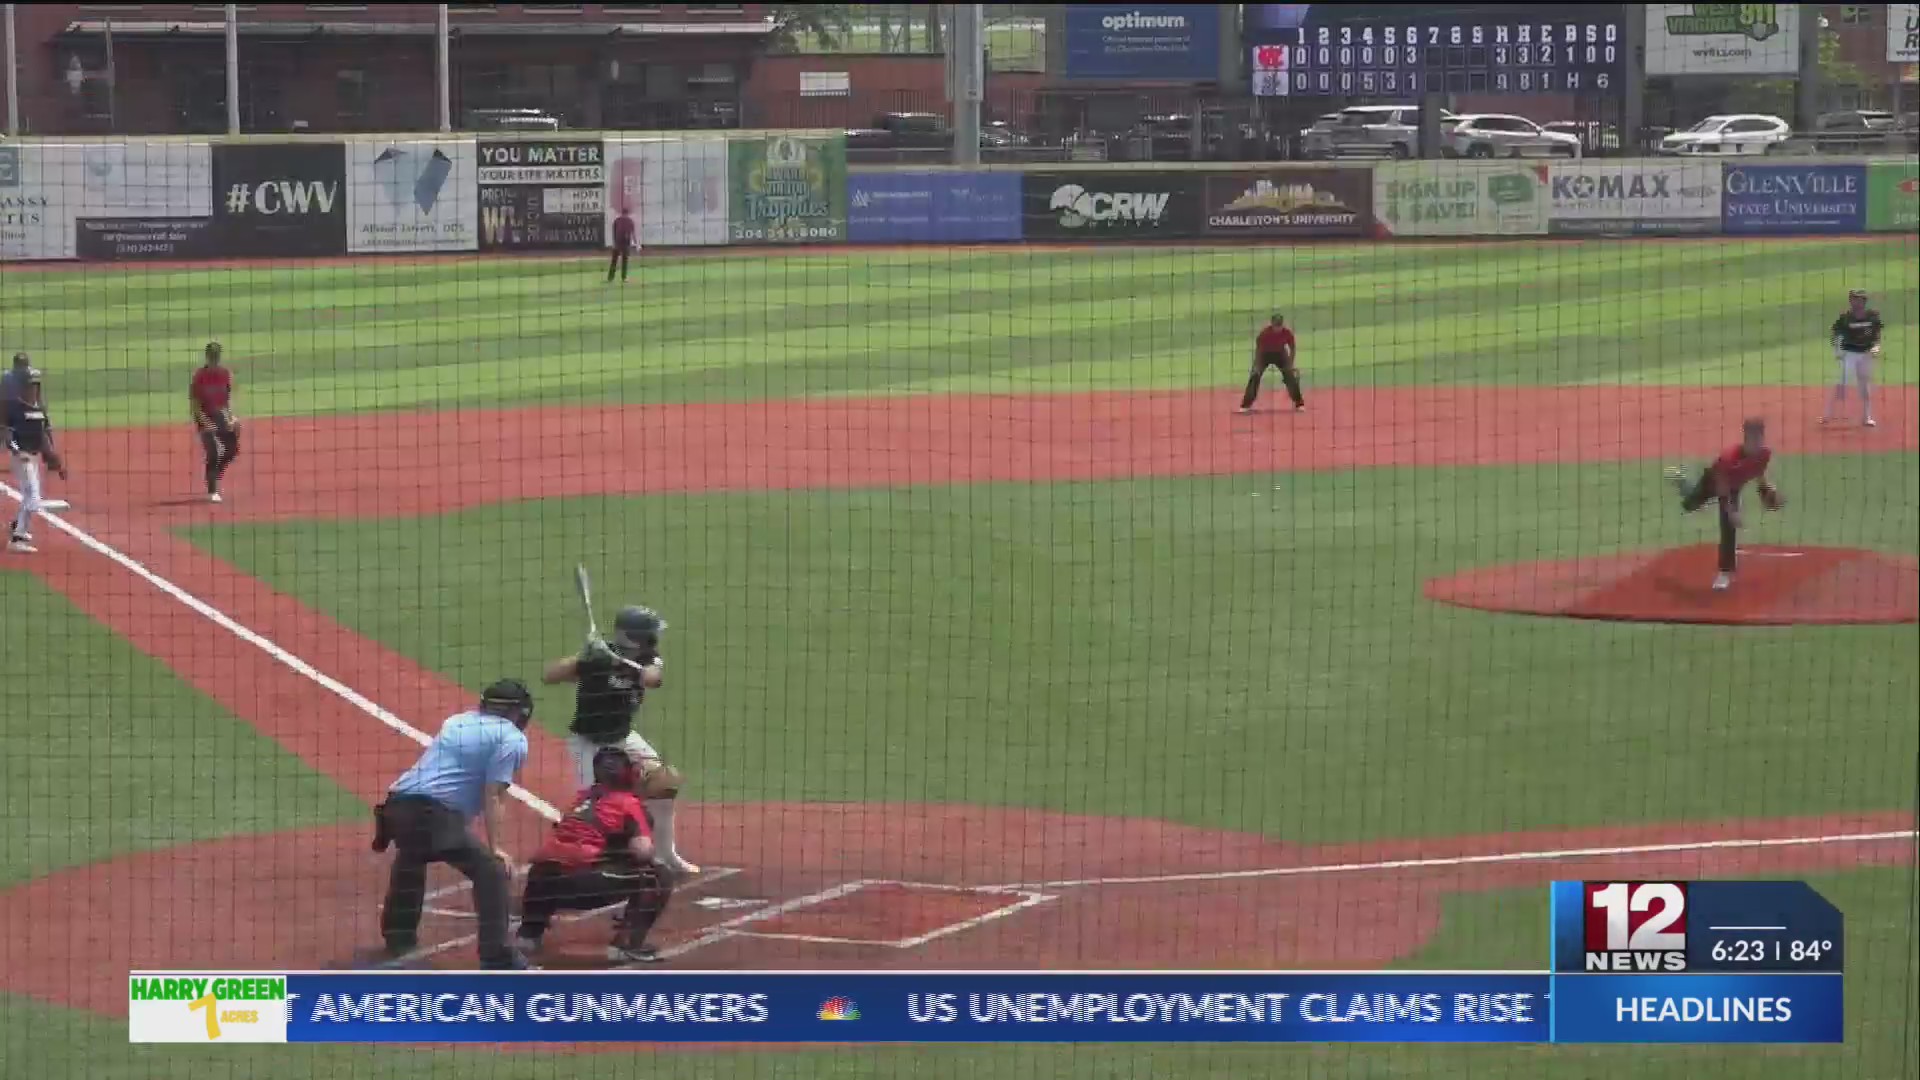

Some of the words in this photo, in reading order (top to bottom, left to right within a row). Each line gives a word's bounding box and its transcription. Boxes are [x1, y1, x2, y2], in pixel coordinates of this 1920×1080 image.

[1102, 11, 1185, 30] optimum
[1298, 27, 1305, 44] 1
[1319, 27, 1329, 44] 2
[1341, 27, 1351, 44] 3
[1362, 27, 1373, 44] 4
[1384, 27, 1395, 44] 5
[1406, 27, 1417, 44] 6
[1428, 27, 1439, 44] 7
[1451, 26, 1461, 43] 8
[1472, 26, 1483, 43] 9
[1518, 25, 1530, 43] H
[1541, 25, 1552, 43] E
[1565, 24, 1577, 42] B
[1585, 24, 1597, 42] S
[1297, 47, 1306, 64] 0
[1319, 47, 1329, 64] 0
[1341, 47, 1350, 64] 0
[1363, 47, 1373, 64] 0
[1384, 47, 1394, 64] 0
[1407, 47, 1416, 64] 3
[1518, 47, 1529, 64] 3
[1541, 47, 1552, 64] 2
[1566, 46, 1574, 63] 1
[1586, 46, 1596, 63] 0
[1605, 46, 1615, 63] 0
[1296, 72, 1306, 89] 0
[1319, 72, 1329, 89] 0
[1341, 72, 1350, 89] 0
[1363, 72, 1373, 89] 5
[1409, 72, 1417, 89] 1
[1542, 72, 1550, 89] 1
[1567, 72, 1579, 89] H
[1597, 72, 1609, 89] 6
[482, 147, 521, 162] YOU
[527, 146, 600, 162] MATTER
[480, 169, 515, 180] YOUR
[545, 168, 600, 180] MATTERS
[1727, 170, 1857, 195] GLENVILLE
[1386, 181, 1440, 199] SIGN
[1446, 180, 1476, 199] UP
[1552, 175, 1670, 199] KOMAX
[226, 180, 338, 214] #CWV
[1089, 192, 1170, 219] CRW
[1728, 202, 1770, 216] STATE
[1774, 200, 1857, 216] UNIVERSITY
[1293, 214, 1355, 225] UNIVERSITY
